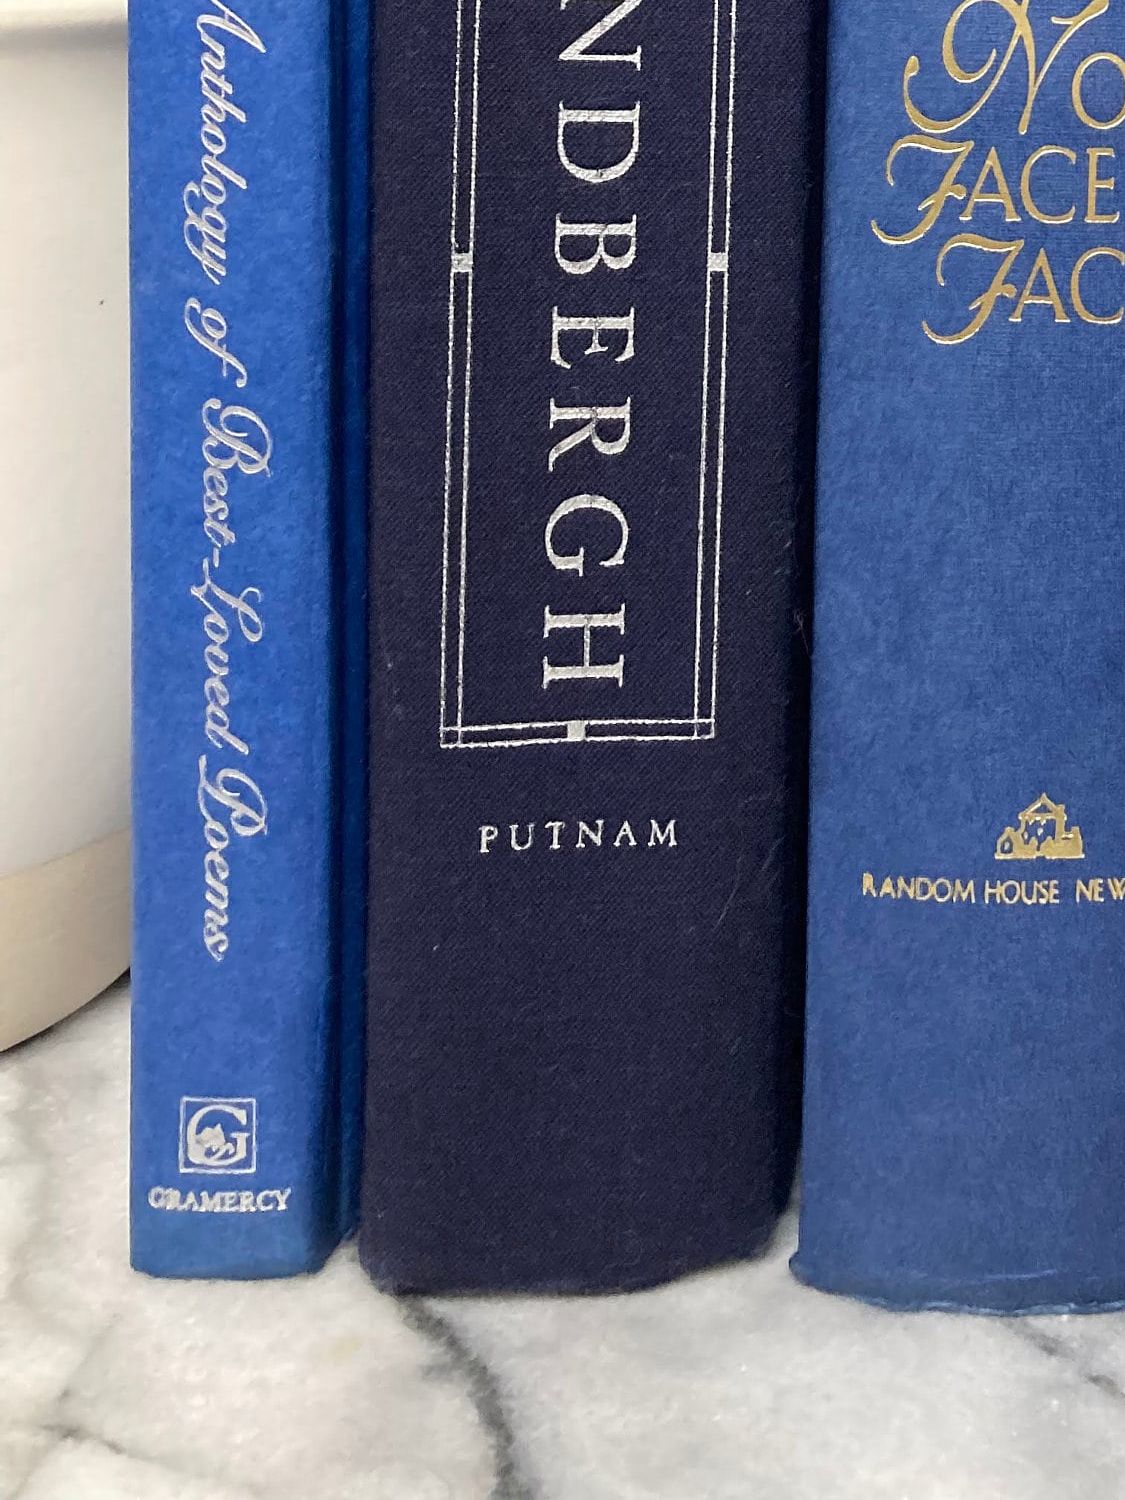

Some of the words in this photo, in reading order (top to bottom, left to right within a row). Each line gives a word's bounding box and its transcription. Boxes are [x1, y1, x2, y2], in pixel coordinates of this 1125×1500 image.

[871, 133, 1121, 246] FACE
[185, 296, 249, 388] of
[190, 397, 274, 757] Best-Loved
[197, 753, 269, 963] Poems
[478, 818, 681, 854] PUTNAM
[862, 871, 976, 904] RANDOM
[984, 879, 1060, 906] HOUSE
[147, 1185, 292, 1213] GRAMERCY
